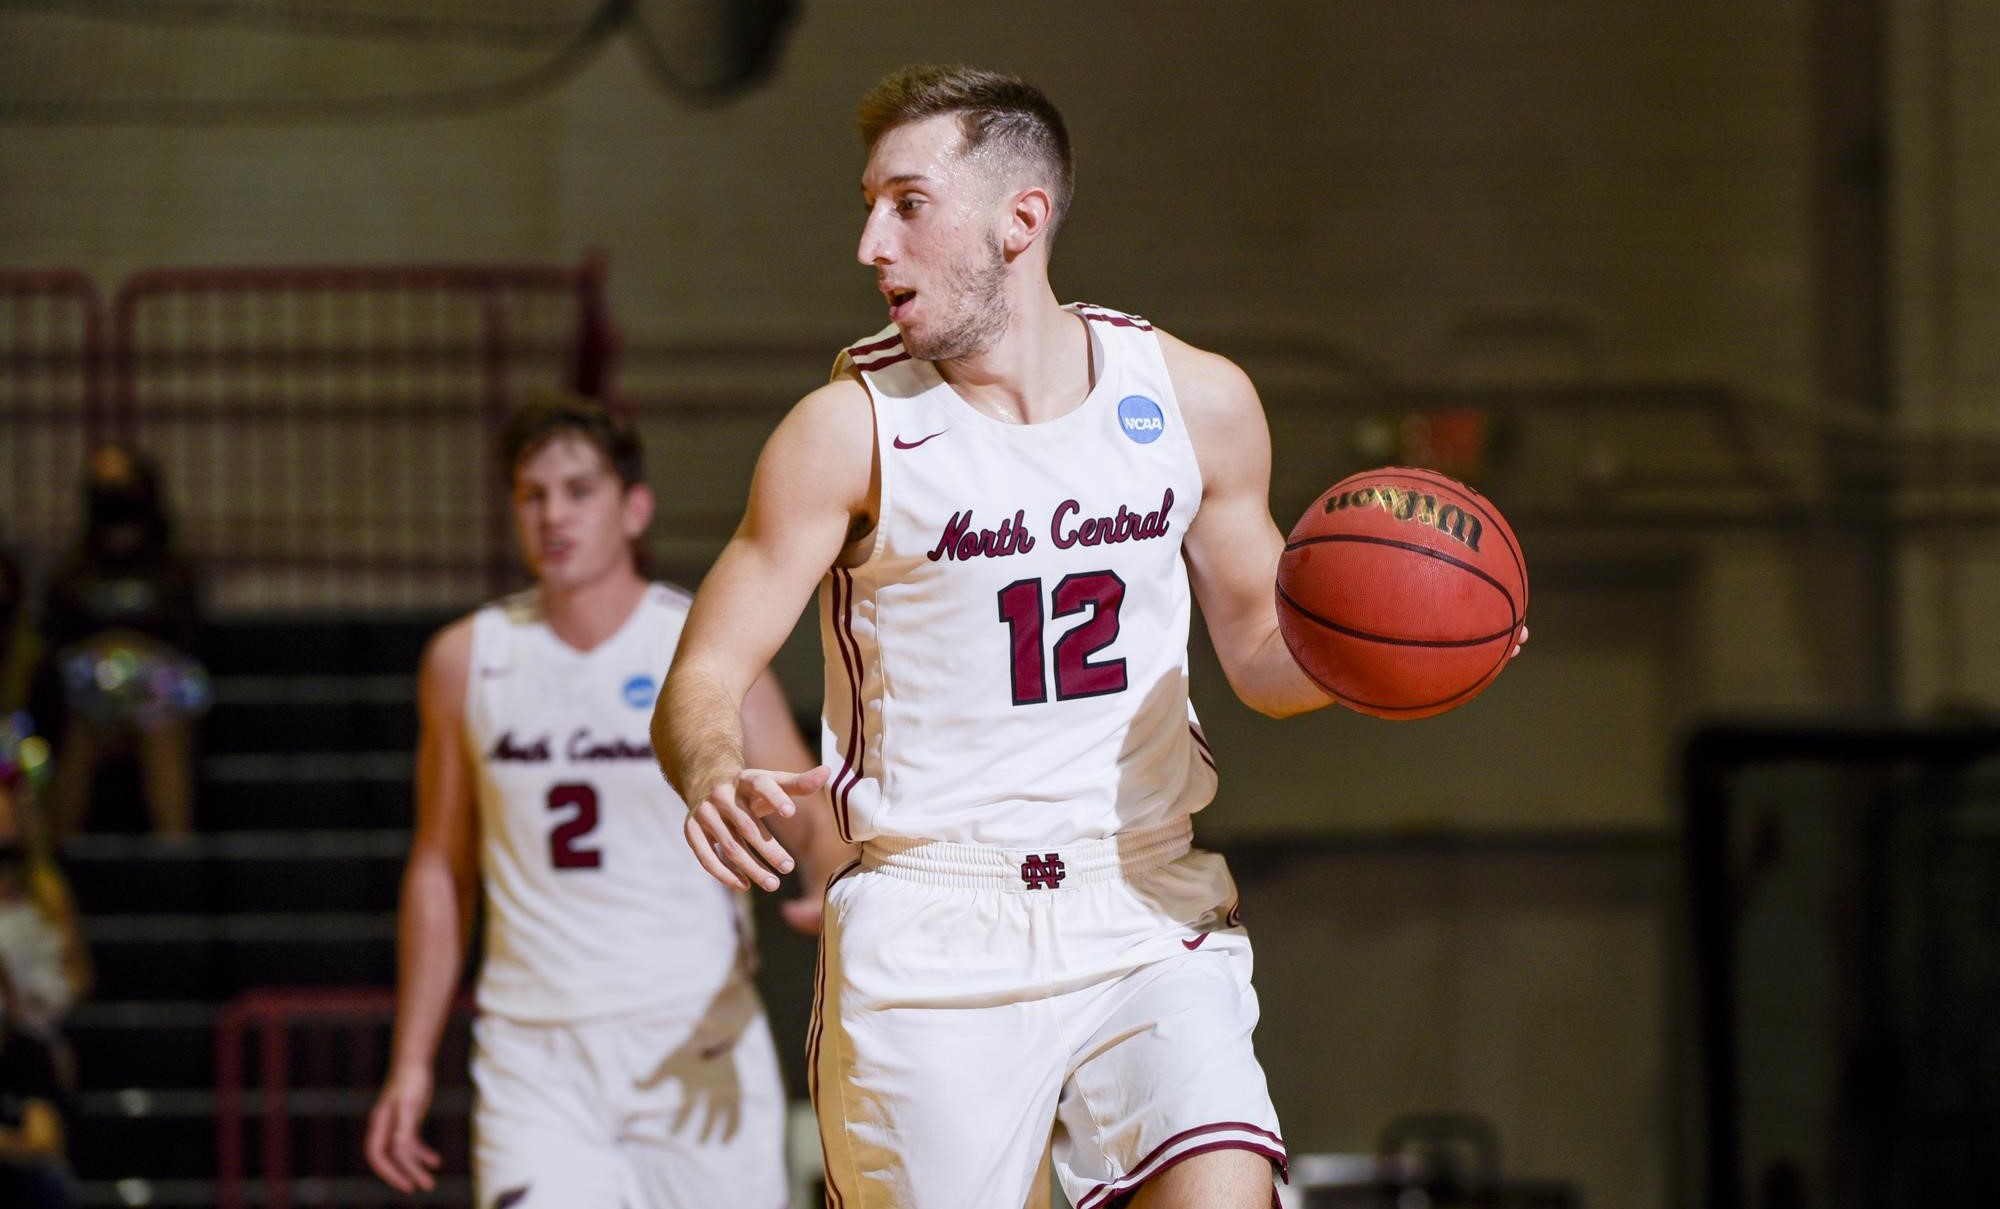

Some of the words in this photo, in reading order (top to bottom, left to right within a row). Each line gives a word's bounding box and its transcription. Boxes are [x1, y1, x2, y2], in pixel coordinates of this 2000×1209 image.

[1124, 416, 1163, 431] NCAA
[927, 509, 1035, 561] North
[1051, 487, 1174, 550] Central
[1324, 486, 1483, 552] Wilson
[997, 569, 1128, 706] 12
[545, 782, 603, 870] 2
